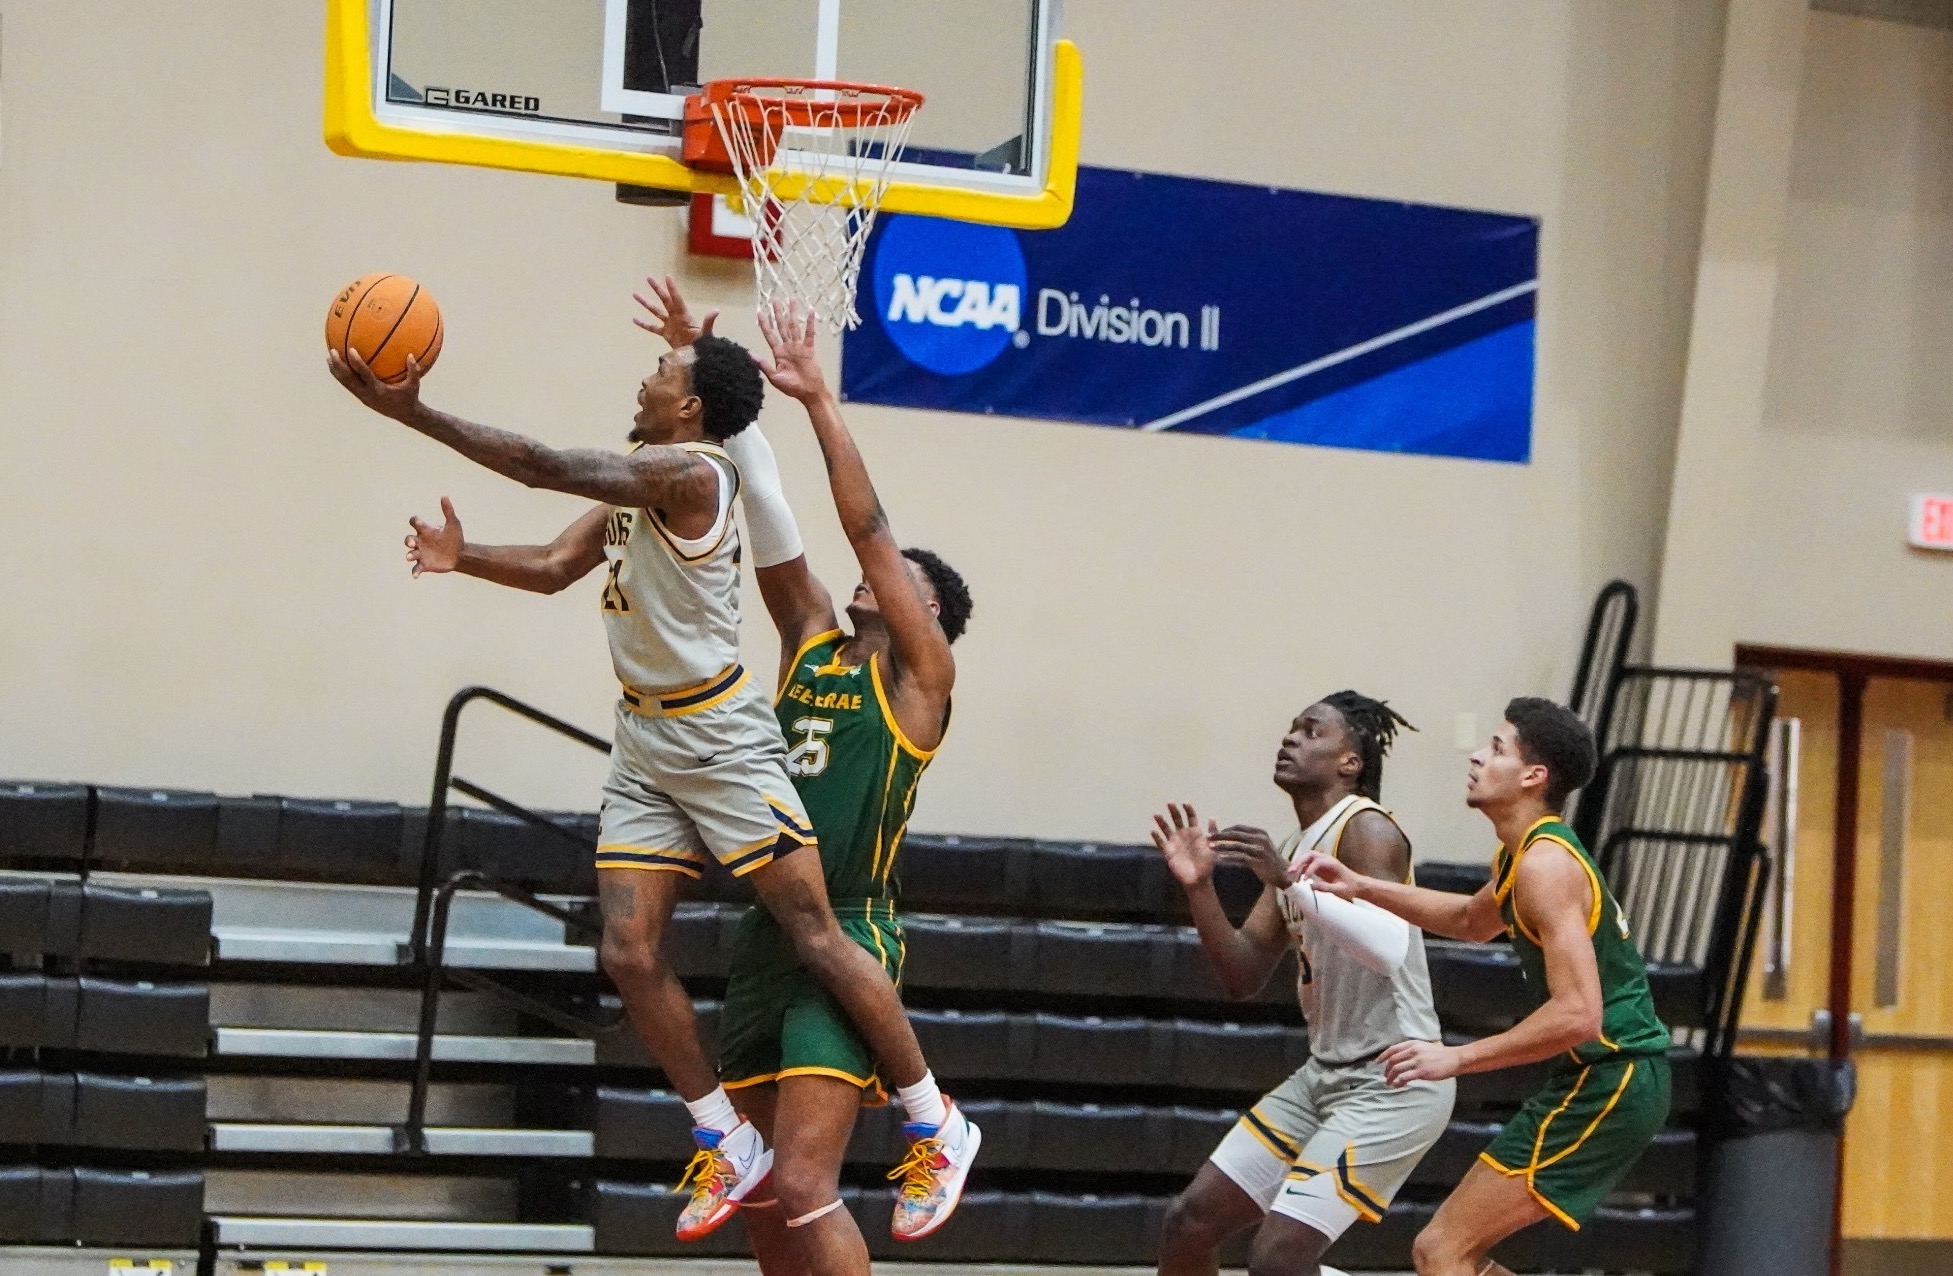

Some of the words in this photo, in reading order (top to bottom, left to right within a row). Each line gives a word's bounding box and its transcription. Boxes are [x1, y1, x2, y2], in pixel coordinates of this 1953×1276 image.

[454, 89, 540, 112] GARED
[888, 274, 1020, 333] NCAA
[1037, 287, 1190, 349] Division
